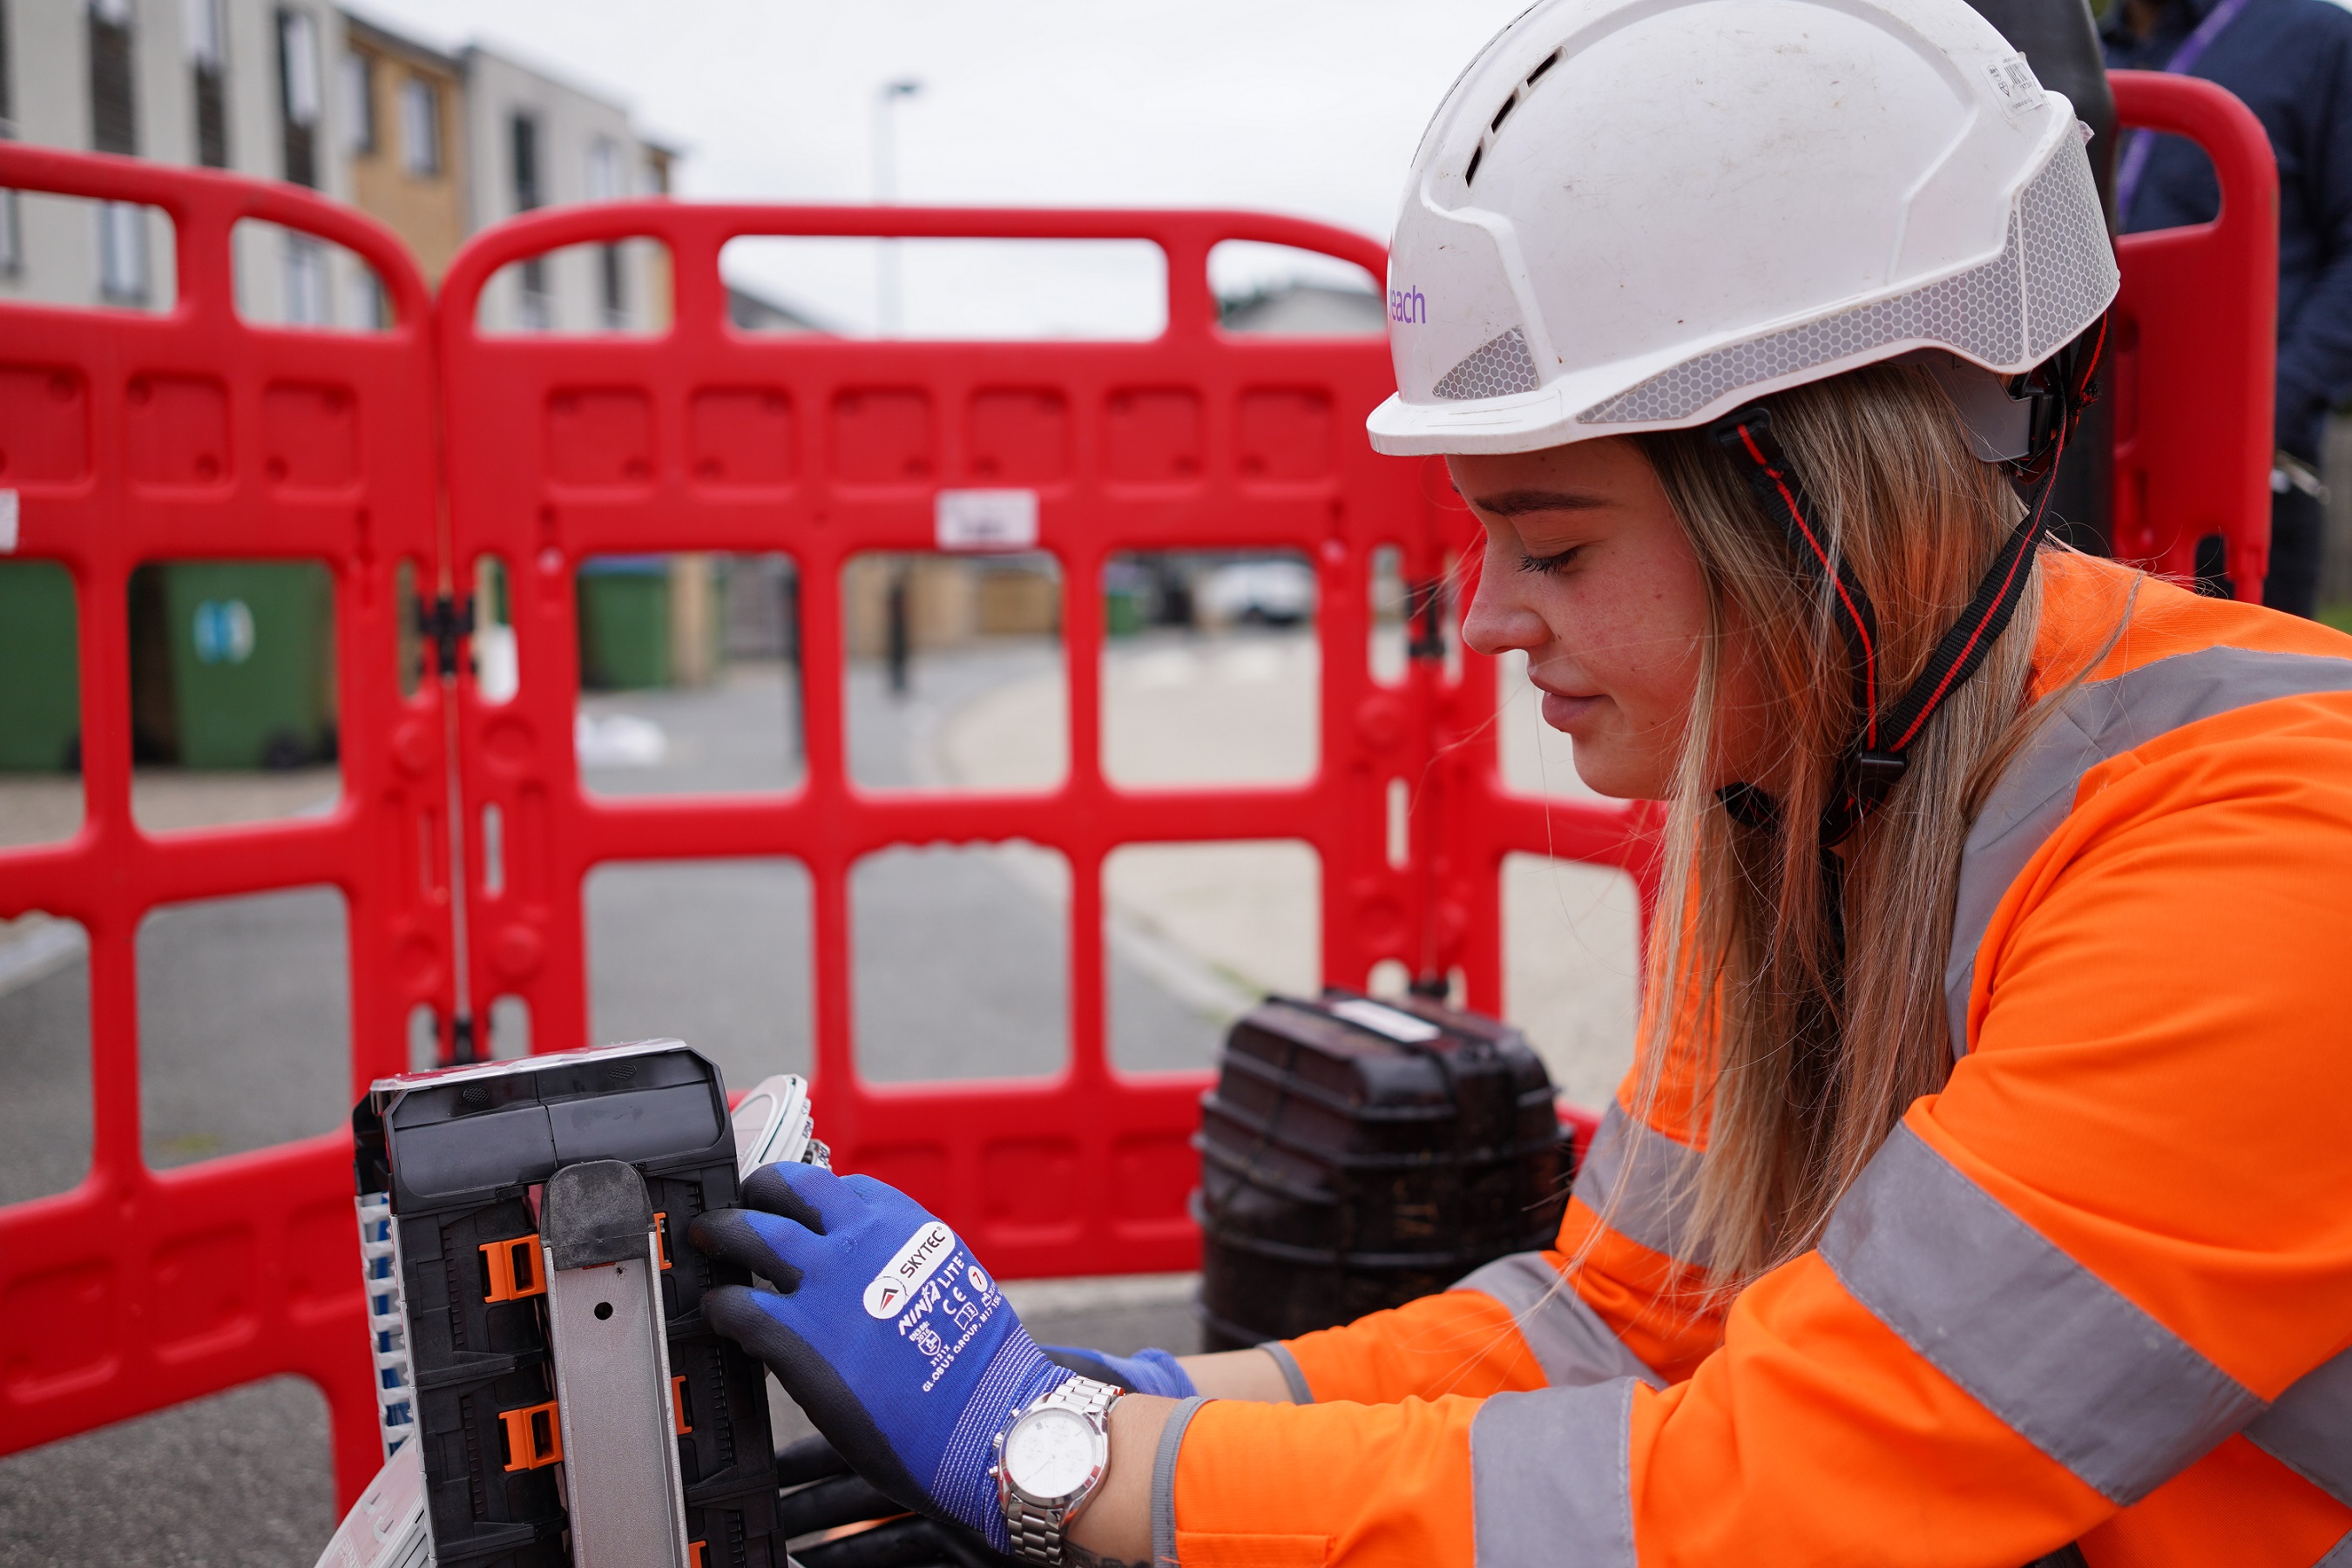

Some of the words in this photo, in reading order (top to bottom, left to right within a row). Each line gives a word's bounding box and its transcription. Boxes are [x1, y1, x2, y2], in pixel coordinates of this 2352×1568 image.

[1390, 284, 1426, 324] each
[972, 1271, 983, 1286] 7
[898, 1280, 942, 1336] NINJA
[936, 1255, 965, 1289] LITE
[916, 1328, 930, 1343] 2016
[923, 1353, 955, 1392] GLOBUS
[953, 1322, 982, 1354] GROUP,
[979, 1307, 993, 1323] M17
[929, 1343, 950, 1367] 3121X
